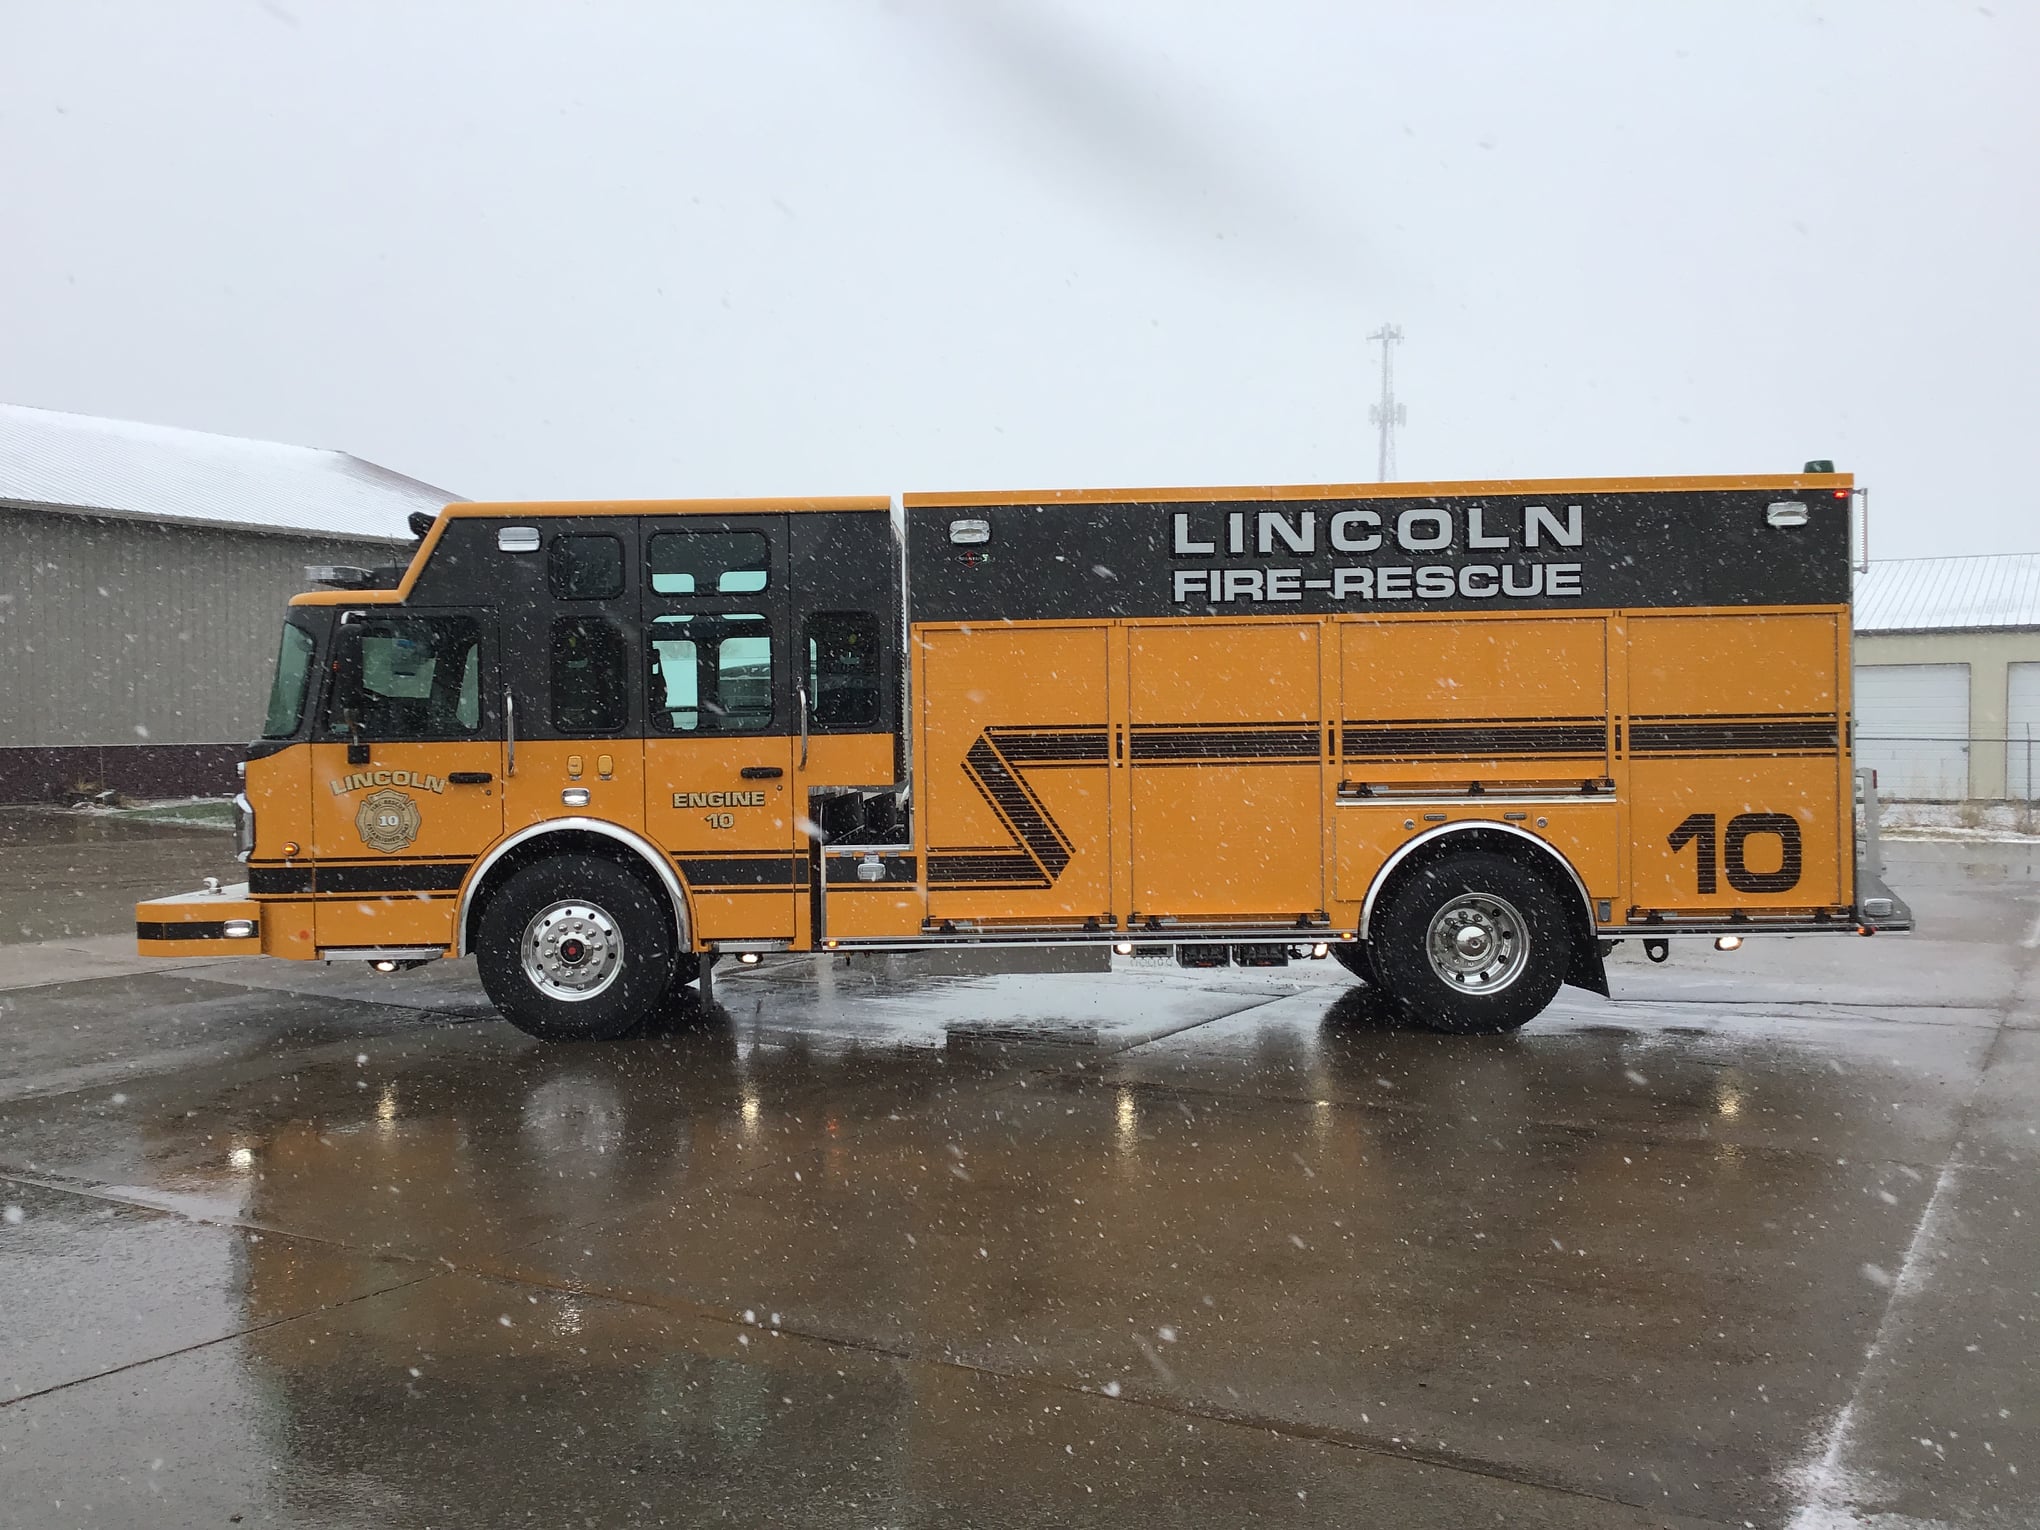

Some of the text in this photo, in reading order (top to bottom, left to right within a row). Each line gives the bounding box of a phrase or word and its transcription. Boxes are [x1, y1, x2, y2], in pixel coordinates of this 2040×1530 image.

[1171, 505, 1583, 557] LINCOLN
[1172, 563, 1583, 603] FIRE-RESCUE
[330, 770, 446, 796] LINCOLN
[672, 791, 765, 808] ENGINE
[379, 815, 399, 827] 10
[705, 813, 734, 829] 10
[1666, 813, 1802, 894] 10
